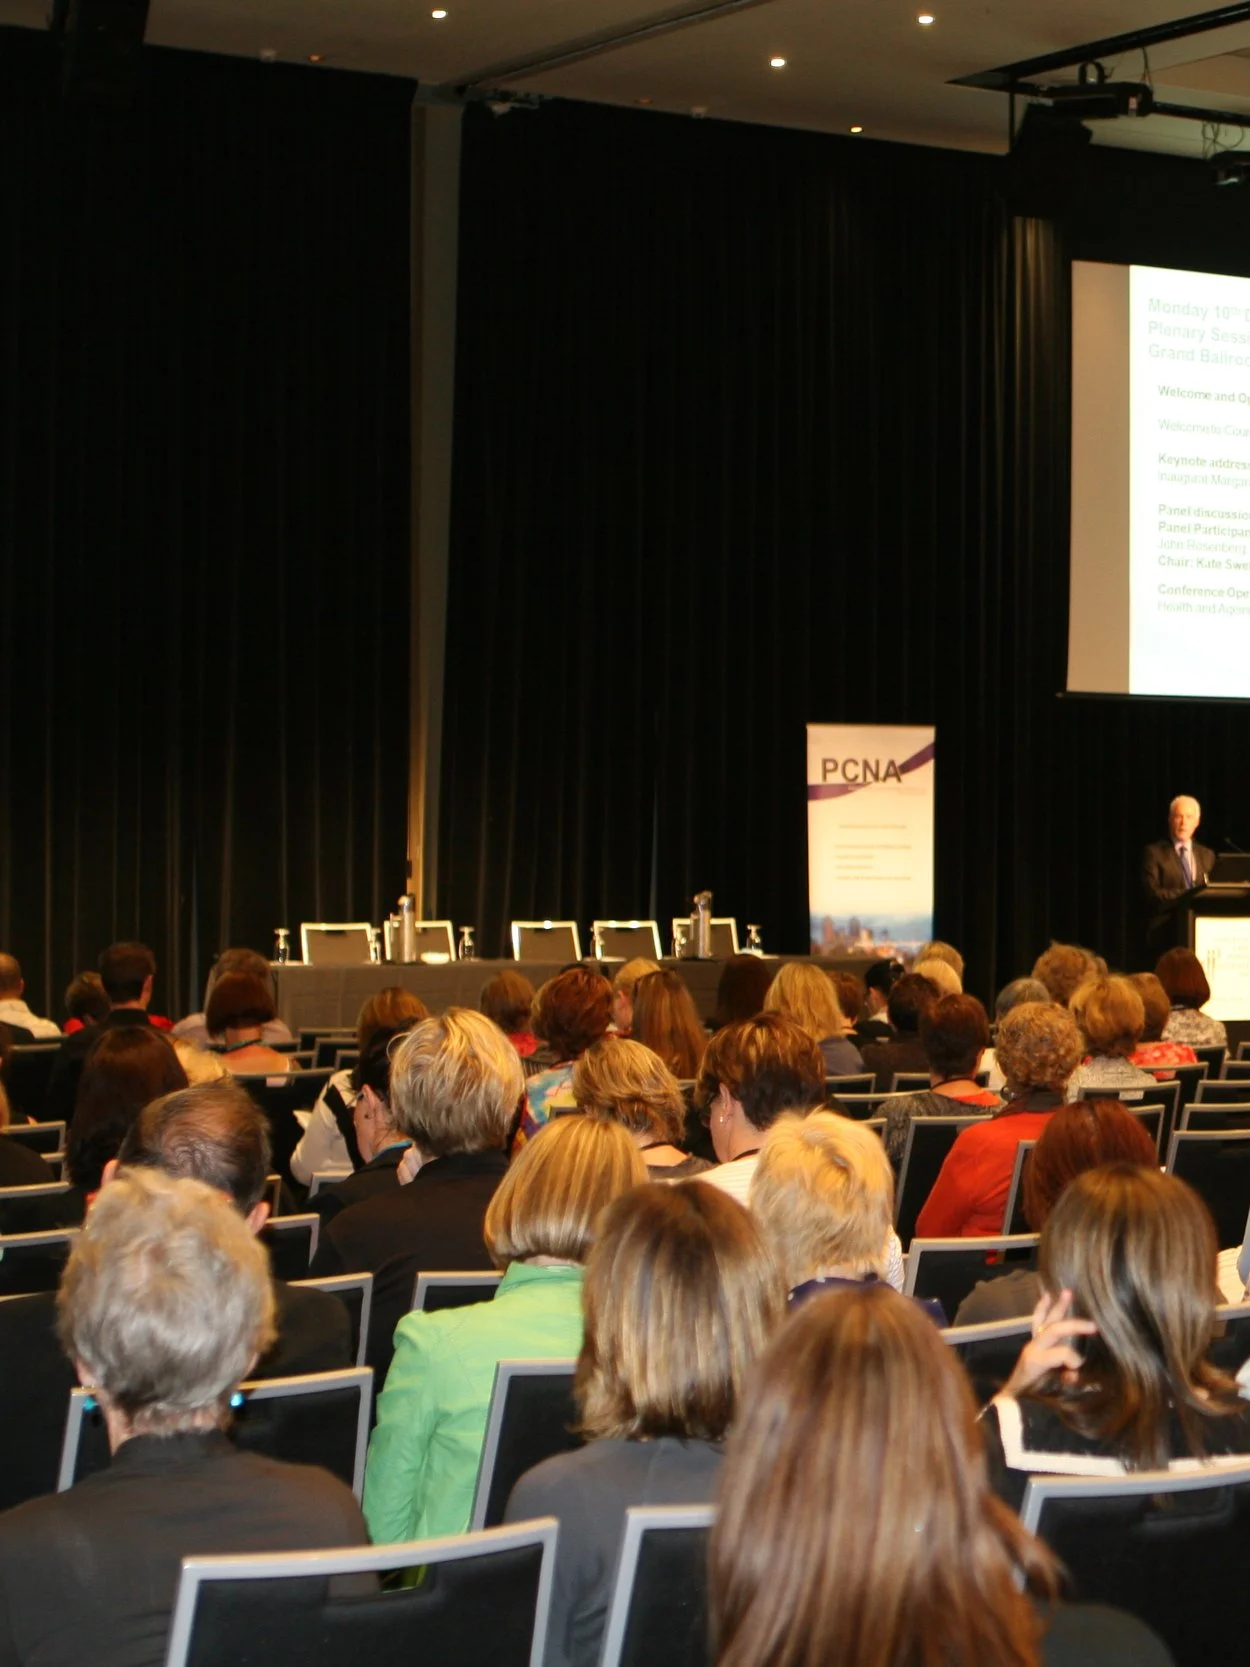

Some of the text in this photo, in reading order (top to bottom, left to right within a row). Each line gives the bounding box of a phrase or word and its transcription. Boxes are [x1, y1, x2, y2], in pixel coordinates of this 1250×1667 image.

[1148, 297, 1208, 321] Monday
[1148, 320, 1206, 344] Plenary
[1148, 343, 1195, 361] Grand
[1157, 384, 1212, 400] Welcome
[1214, 391, 1236, 404] and
[1158, 452, 1206, 468] Keynote
[1158, 503, 1191, 517] Panel
[1158, 520, 1191, 534] Panel
[1157, 554, 1194, 570] Chair:
[1196, 556, 1222, 570] Kate
[1157, 583, 1225, 599] Conference
[821, 758, 903, 783] PCNA
